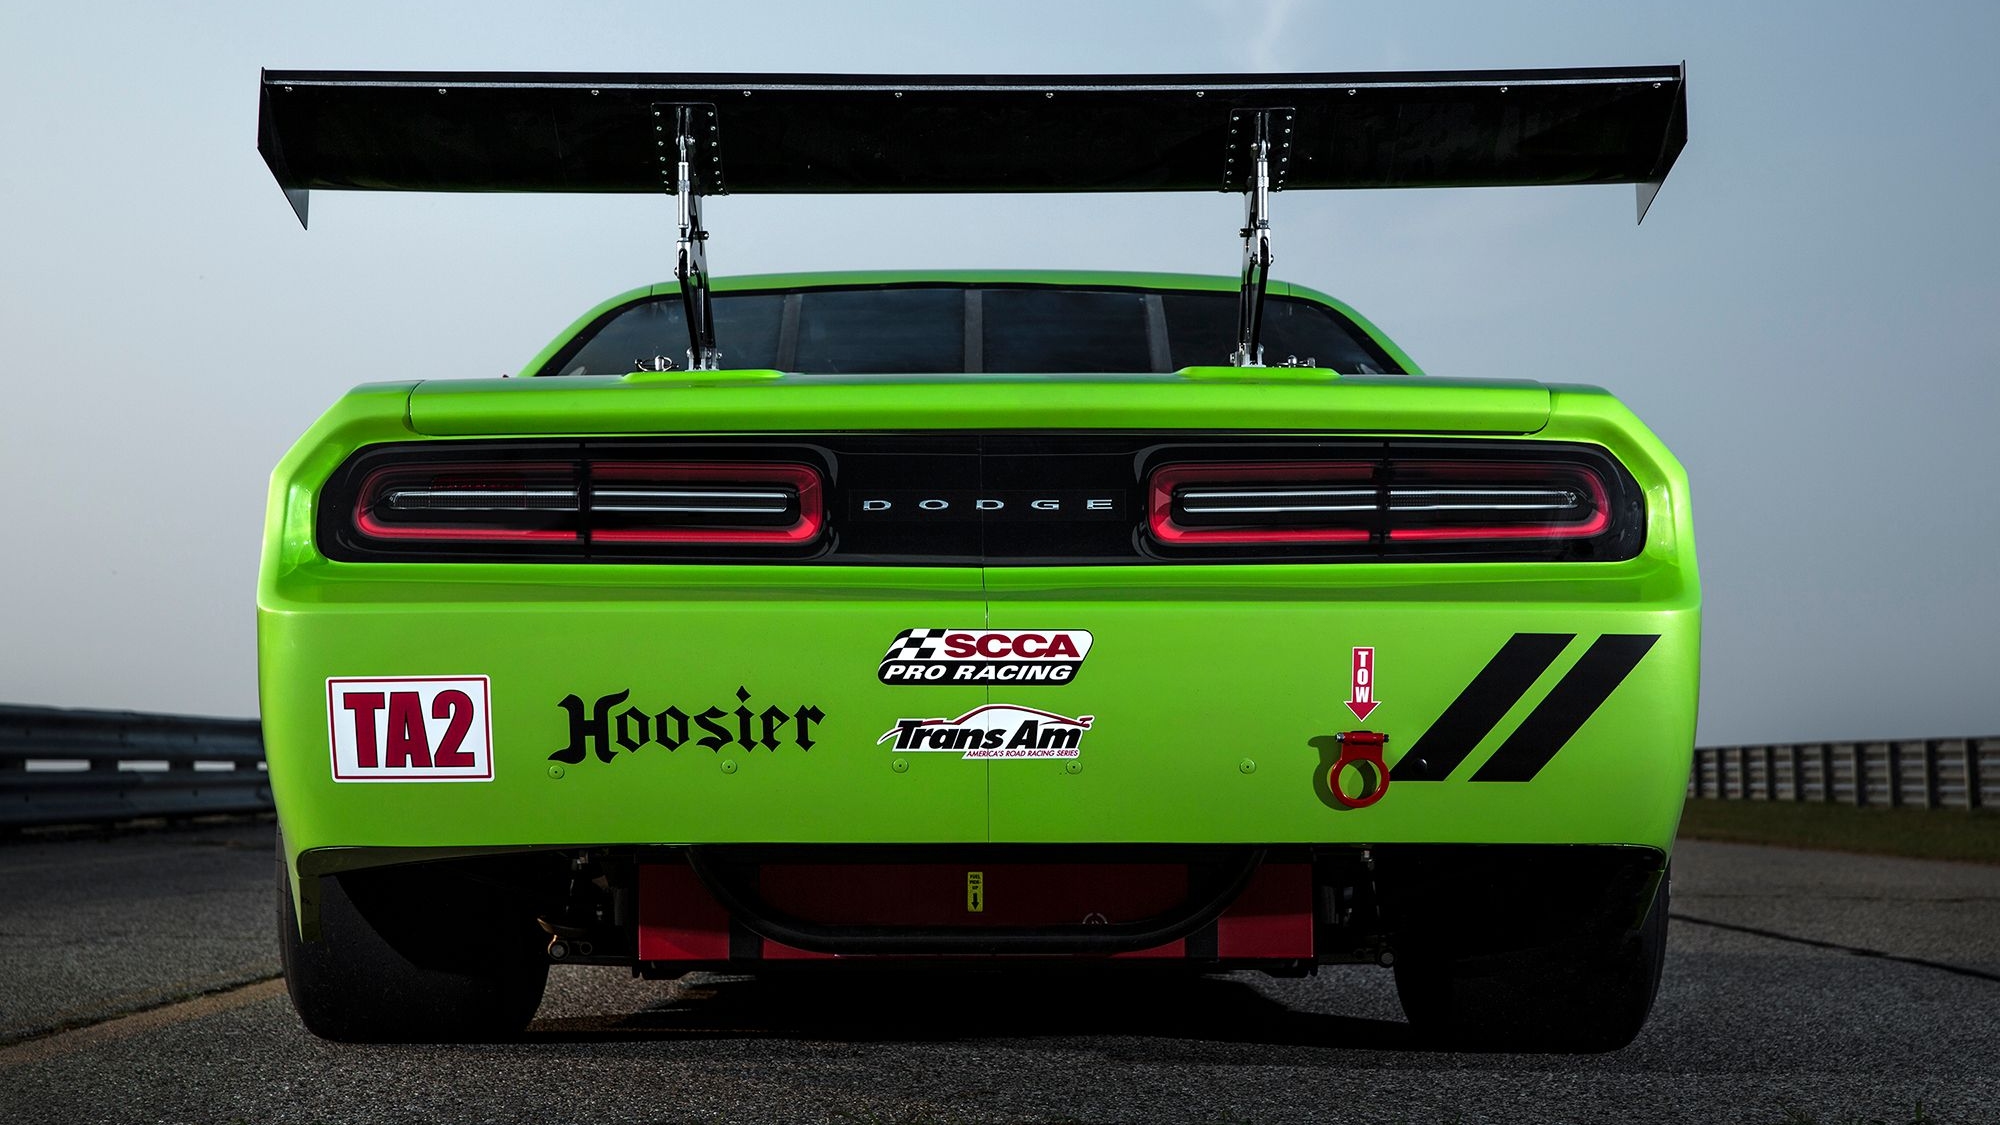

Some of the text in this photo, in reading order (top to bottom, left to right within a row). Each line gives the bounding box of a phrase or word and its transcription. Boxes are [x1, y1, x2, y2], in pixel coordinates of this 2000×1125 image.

[863, 499, 1113, 511] DODGE
[944, 633, 1081, 658] SCCA
[883, 664, 1073, 681] PRO RACING
[1355, 650, 1370, 703] TOW
[343, 690, 475, 768] TA2
[548, 686, 826, 764] Hoosier
[896, 720, 1083, 750] Trans Am
